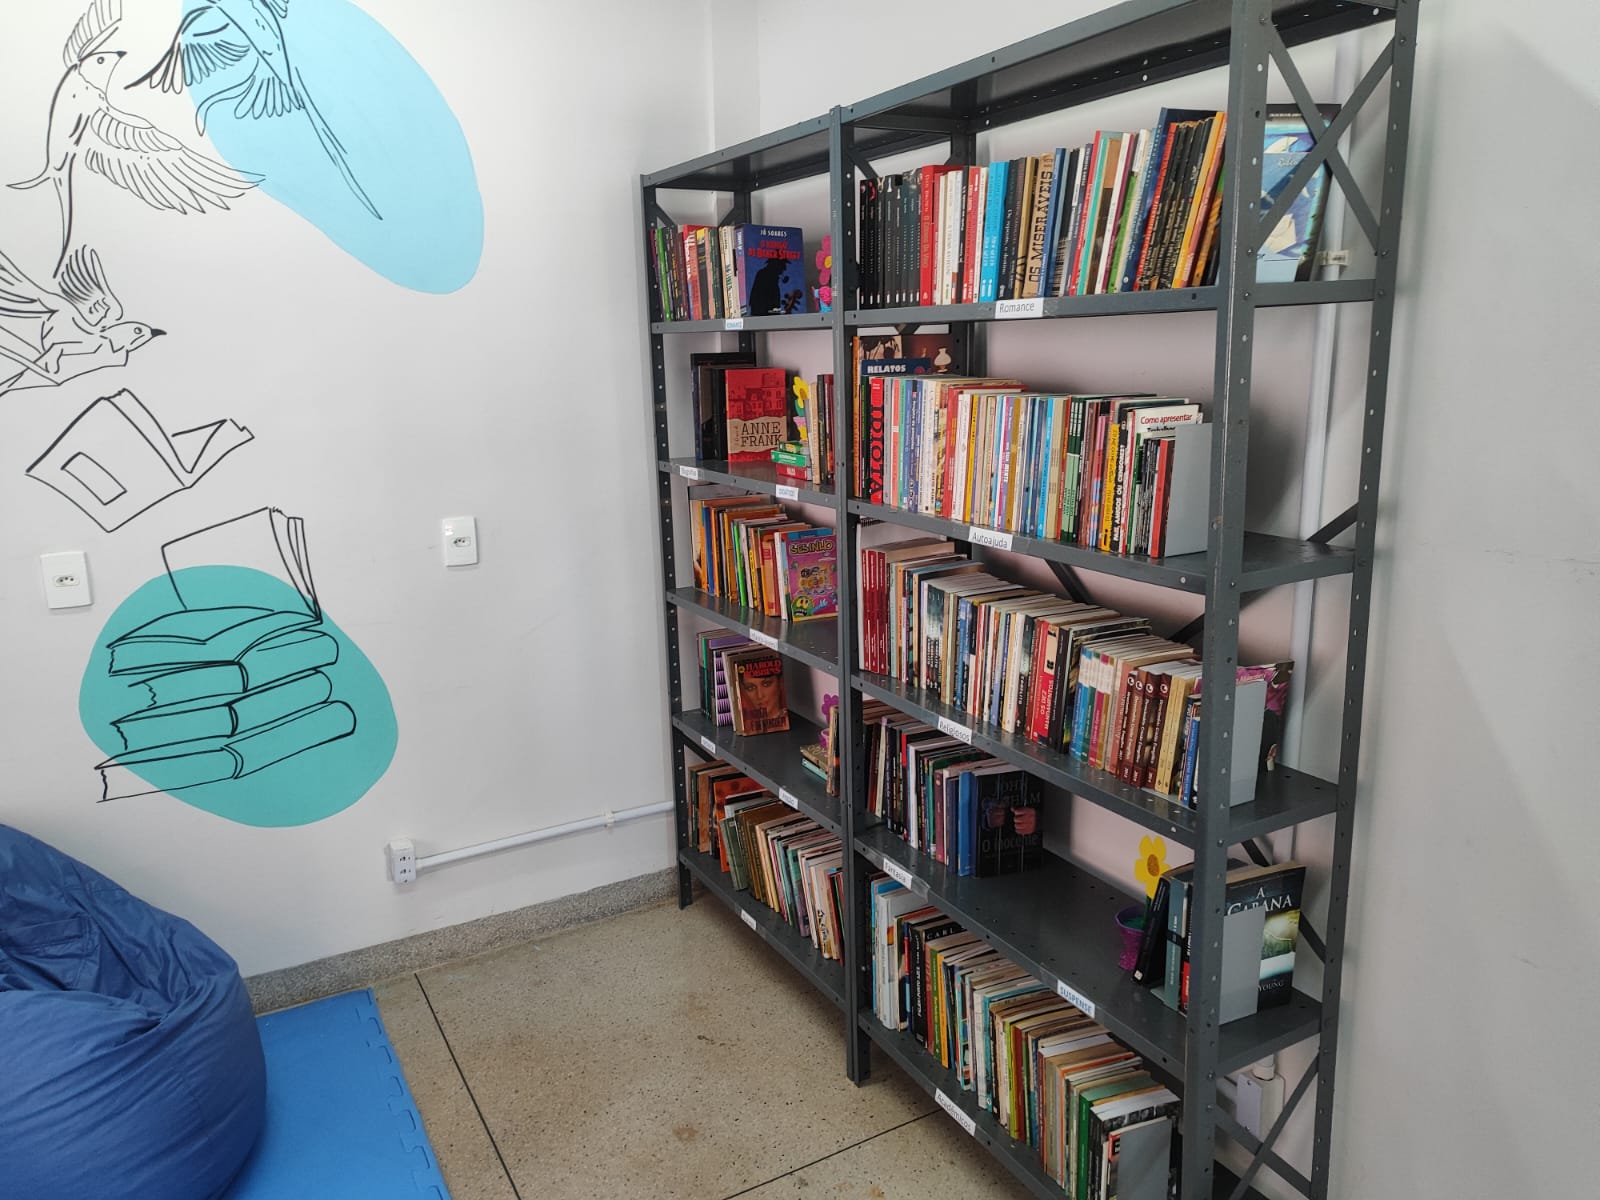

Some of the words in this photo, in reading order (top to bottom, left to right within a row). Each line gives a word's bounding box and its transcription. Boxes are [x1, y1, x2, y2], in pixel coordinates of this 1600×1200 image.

[1030, 170, 1053, 262] MISERÁVEIS
[1027, 266, 1042, 283] OS
[999, 301, 1035, 314] Romance
[867, 364, 906, 375] RELATOS
[740, 421, 781, 436] ANNE
[1140, 415, 1159, 428] Como
[1159, 413, 1193, 428] apresentar
[740, 434, 782, 448] FRANK
[869, 405, 884, 498] IDIOTA
[1118, 444, 1126, 482] CENSORES?
[1117, 484, 1122, 495] OU
[1114, 497, 1122, 523] AMIGOS
[790, 539, 833, 555] SESINHO
[972, 531, 1008, 549] Autoajuda
[745, 659, 782, 673] HAROLD
[1040, 704, 1046, 715] OS
[1044, 679, 1054, 729] MANDAMENTOS
[939, 720, 971, 743] Religiosos
[885, 862, 908, 884] Fantasia
[1256, 886, 1265, 899] A
[1226, 893, 1292, 915] CABANA
[1059, 986, 1093, 1015] SUSPENSE
[937, 1093, 974, 1133] Acadêmicos
